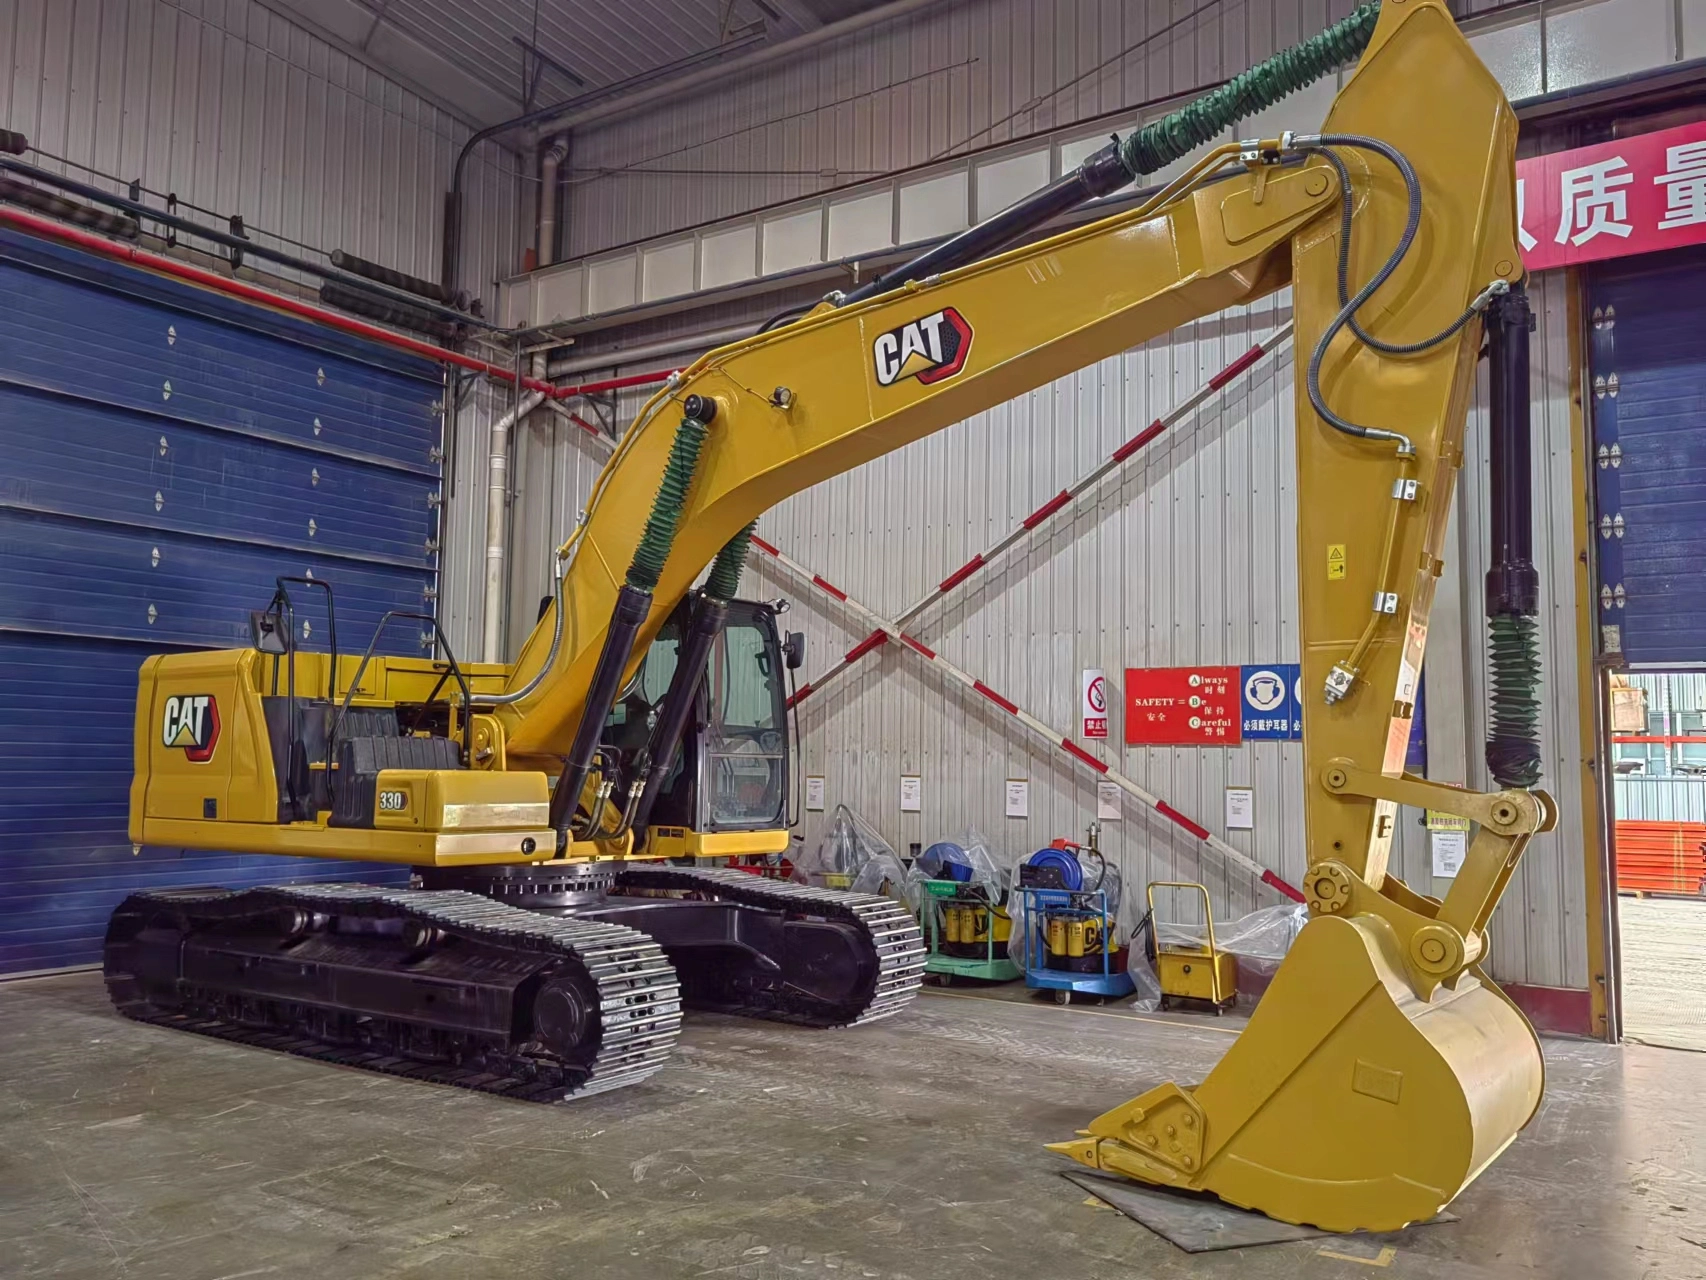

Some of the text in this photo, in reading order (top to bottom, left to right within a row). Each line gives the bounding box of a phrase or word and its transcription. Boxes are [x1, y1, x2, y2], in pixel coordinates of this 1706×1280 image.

[874, 311, 945, 385] CAT
[1191, 676, 1228, 685] Always
[1135, 698, 1175, 706] SAFETY
[1191, 697, 1207, 706] Be
[163, 696, 209, 746] CAT
[1146, 712, 1166, 722] 安全
[1191, 718, 1231, 727] Careful
[380, 791, 402, 809] 330
